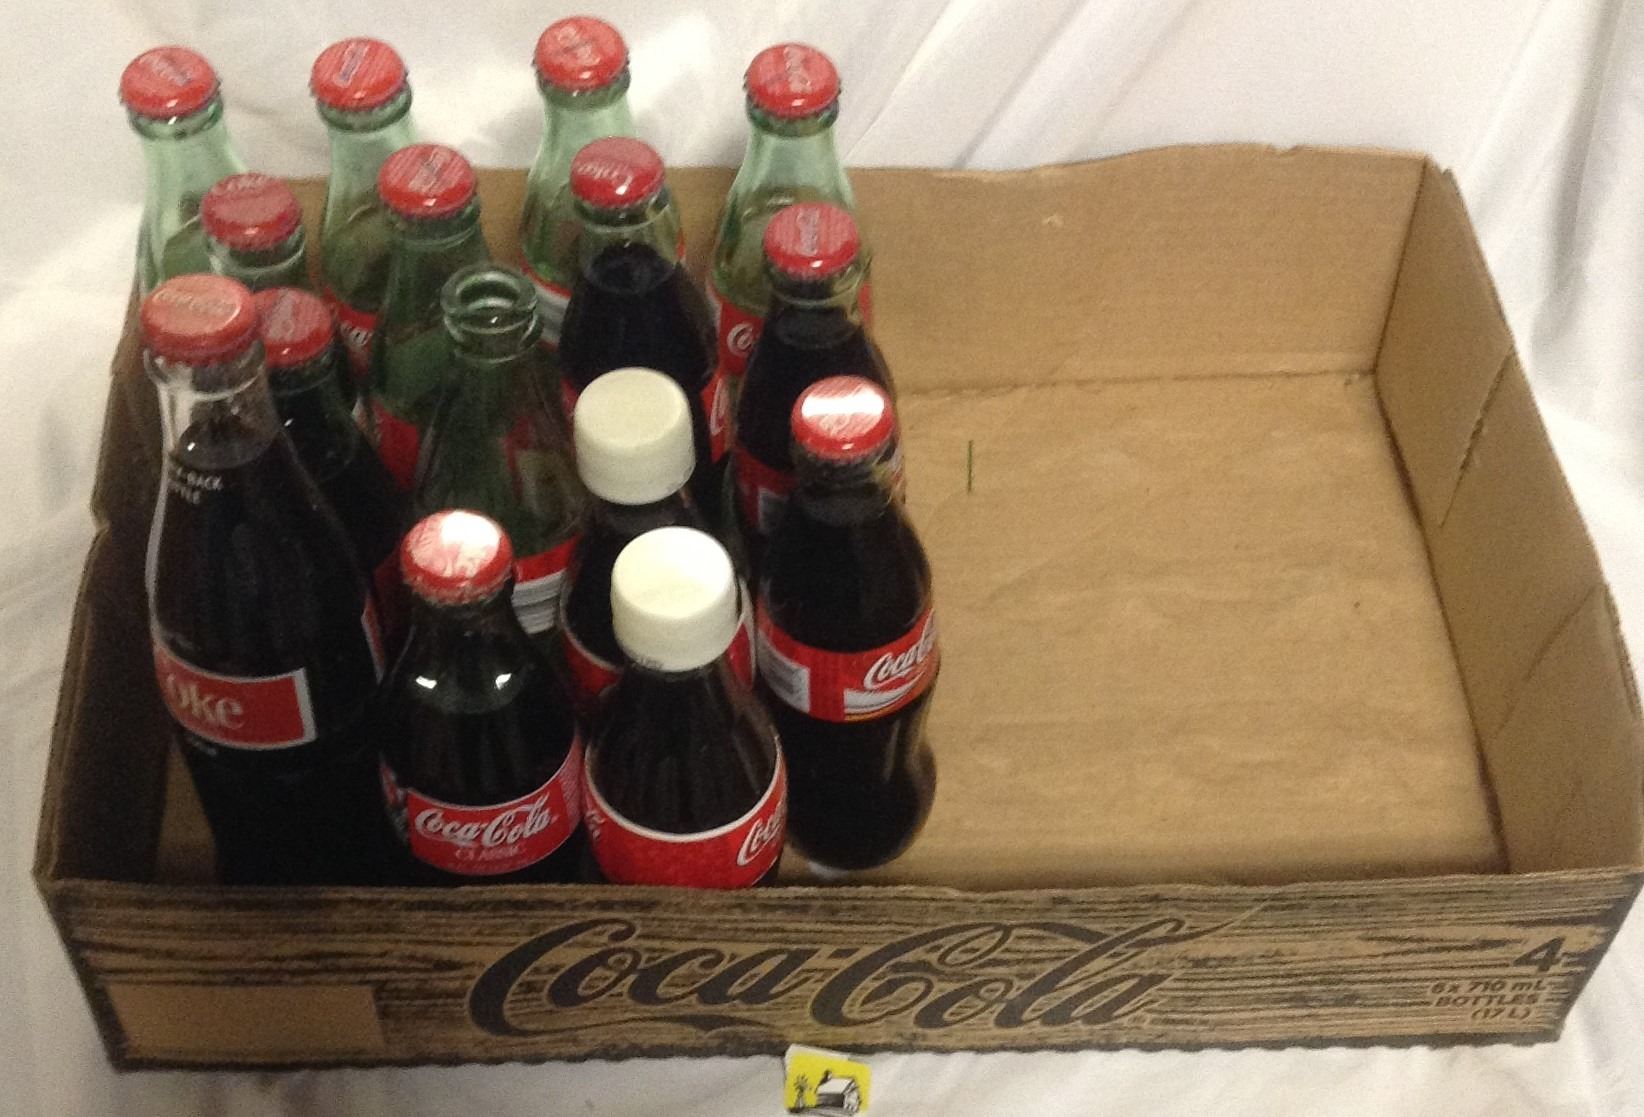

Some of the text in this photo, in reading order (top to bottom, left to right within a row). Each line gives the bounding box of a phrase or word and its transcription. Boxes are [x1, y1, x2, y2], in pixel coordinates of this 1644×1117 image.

[415, 793, 553, 848] Coca-Cola
[1512, 935, 1568, 973] 4
[469, 917, 1234, 1037] Coca-Cola
[1468, 980, 1508, 993] 710
[1434, 993, 1541, 1008] BOTTLES
